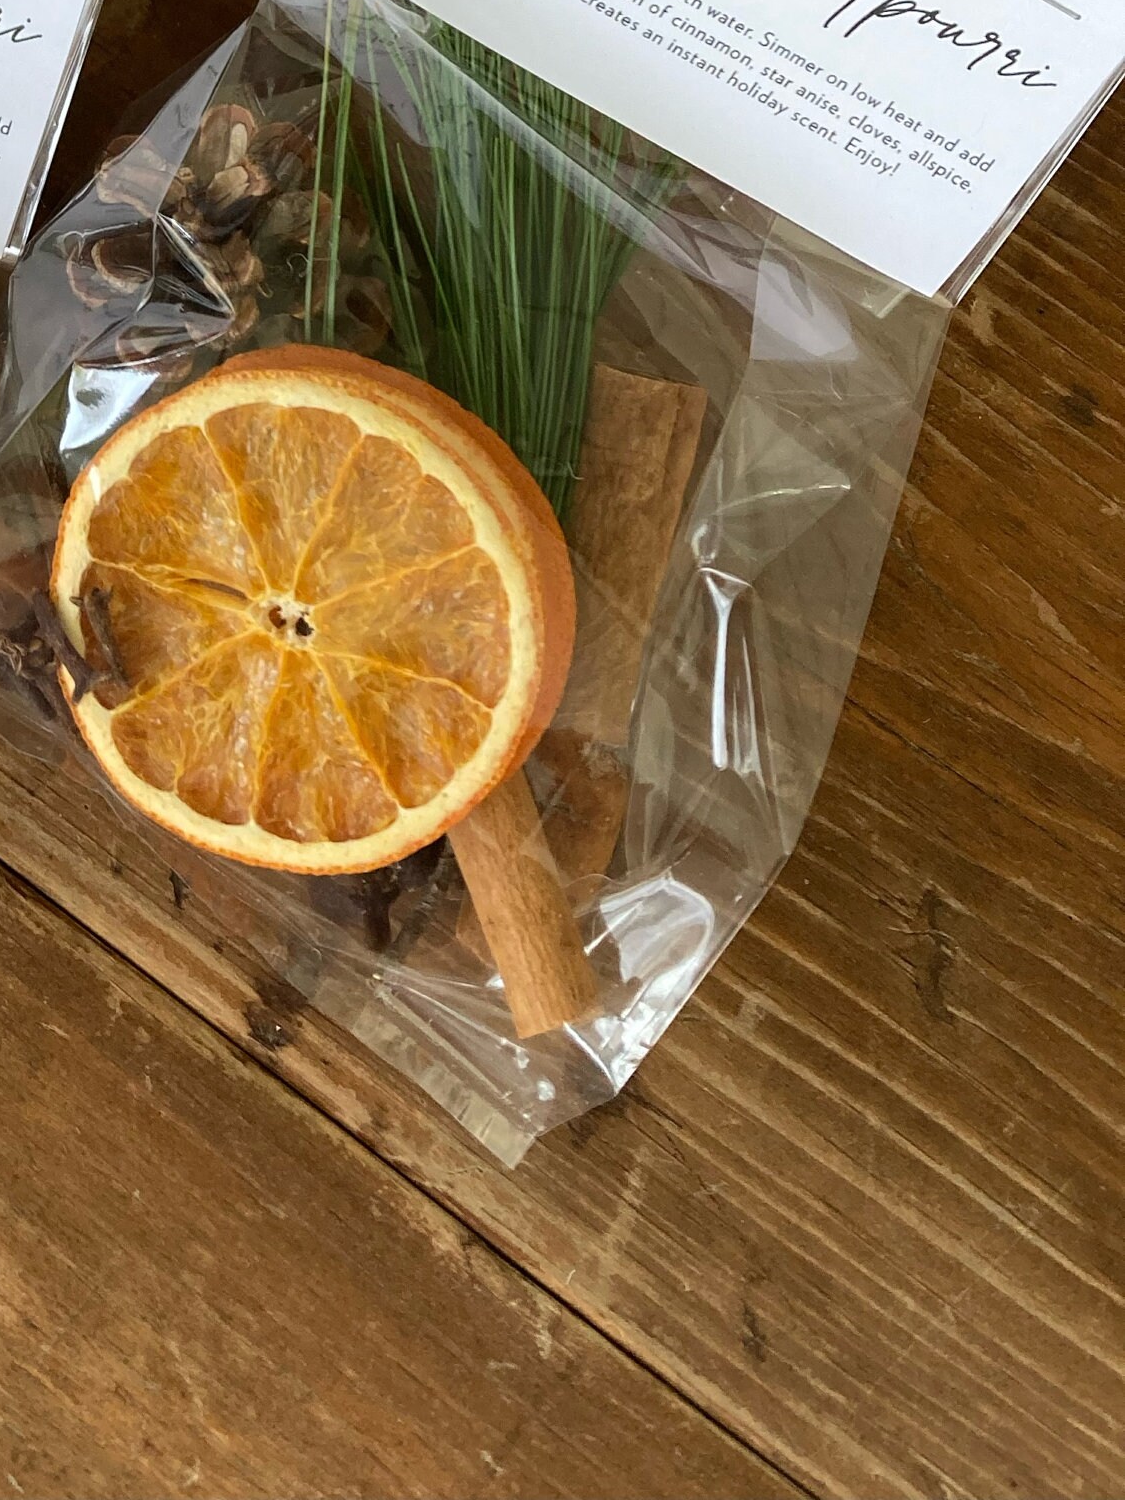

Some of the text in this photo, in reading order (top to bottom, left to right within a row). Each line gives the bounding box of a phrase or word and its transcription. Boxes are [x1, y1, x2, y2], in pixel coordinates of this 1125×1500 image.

[642, 28, 664, 46] an
[666, 38, 726, 80] instant
[726, 69, 790, 116] holiday
[790, 111, 838, 145] scent.
[843, 136, 902, 177] Enjoy!
[648, 3, 674, 19] of
[670, 16, 754, 71] cinnamon,
[759, 66, 795, 89] star
[795, 86, 841, 120] anise,
[847, 114, 902, 155] cloves,
[908, 149, 972, 194] allspice,
[706, 5, 755, 40] water.
[757, 31, 825, 76] Simmer
[825, 74, 849, 92] on
[849, 82, 882, 109] low
[882, 100, 923, 133] heat
[923, 128, 961, 153] and
[958, 149, 996, 173] add
